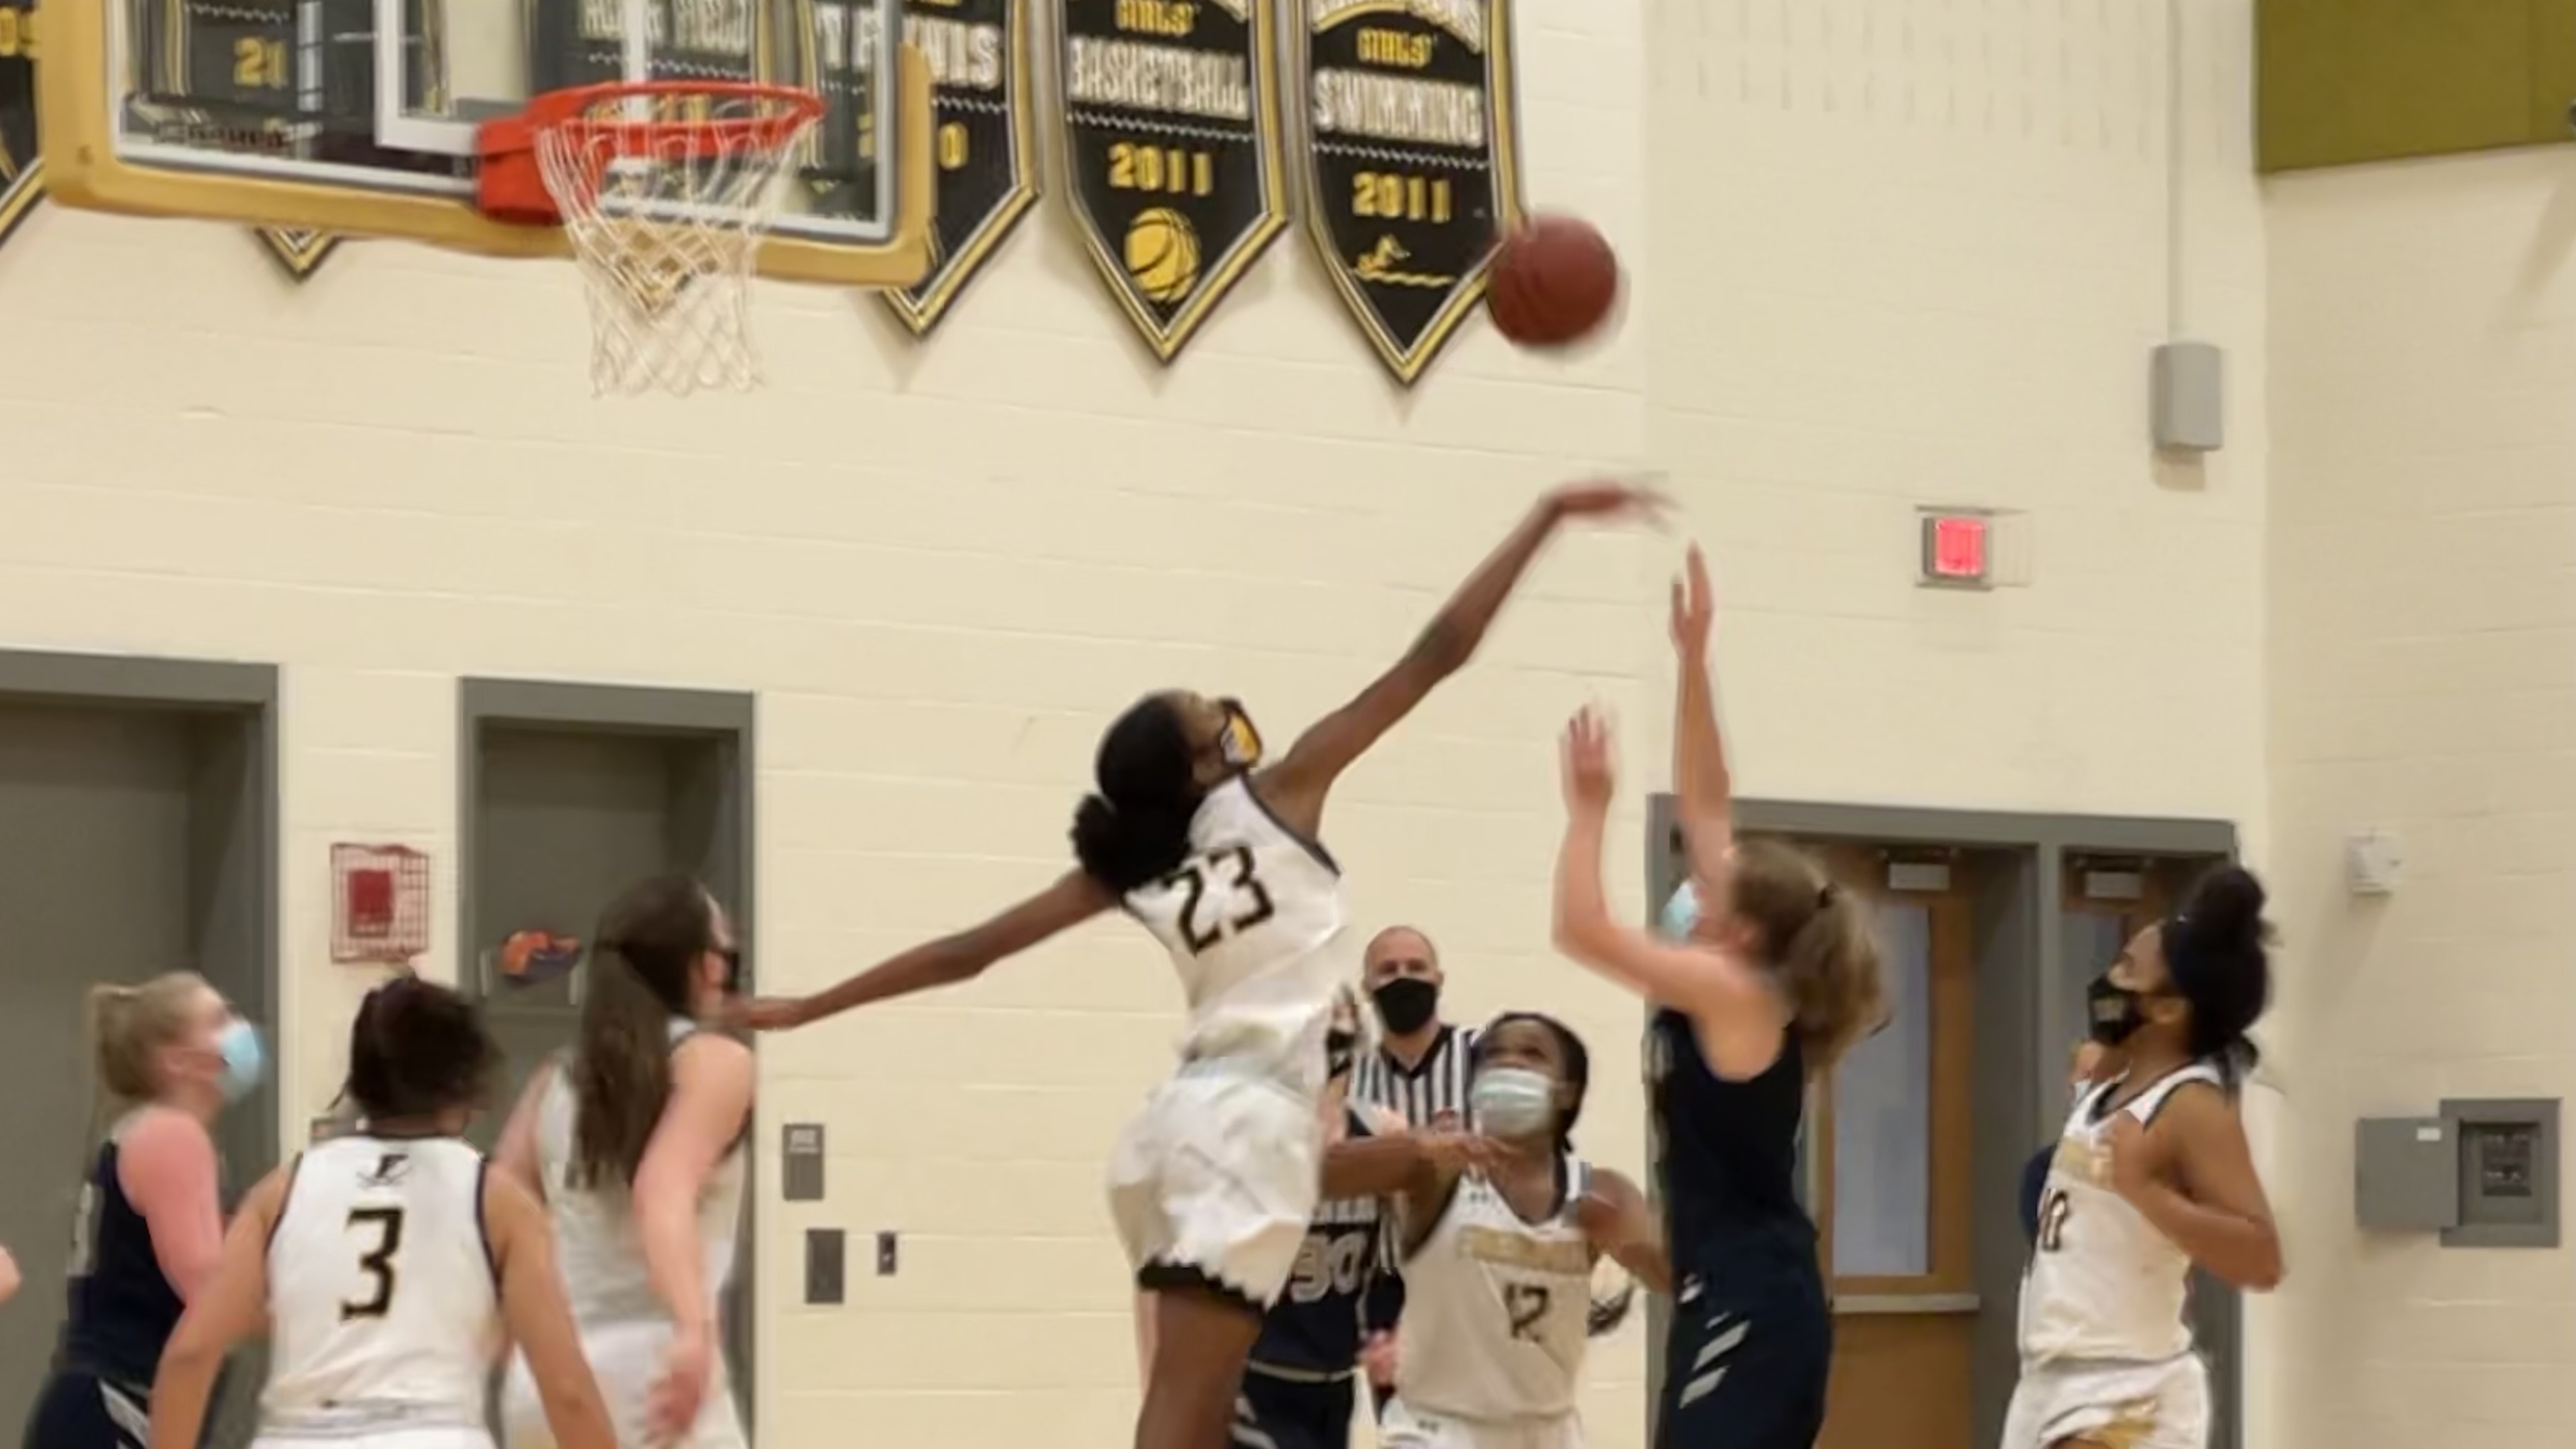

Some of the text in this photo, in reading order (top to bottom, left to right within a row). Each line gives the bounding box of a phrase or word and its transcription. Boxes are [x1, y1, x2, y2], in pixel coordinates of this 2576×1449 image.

[1067, 36, 1249, 119] BASKETBALL
[1314, 68, 1483, 147] SWIMMING
[1108, 143, 1213, 197] 2011
[1352, 171, 1452, 224] 2011
[1161, 845, 1275, 956] 23
[339, 1205, 405, 1323] 3
